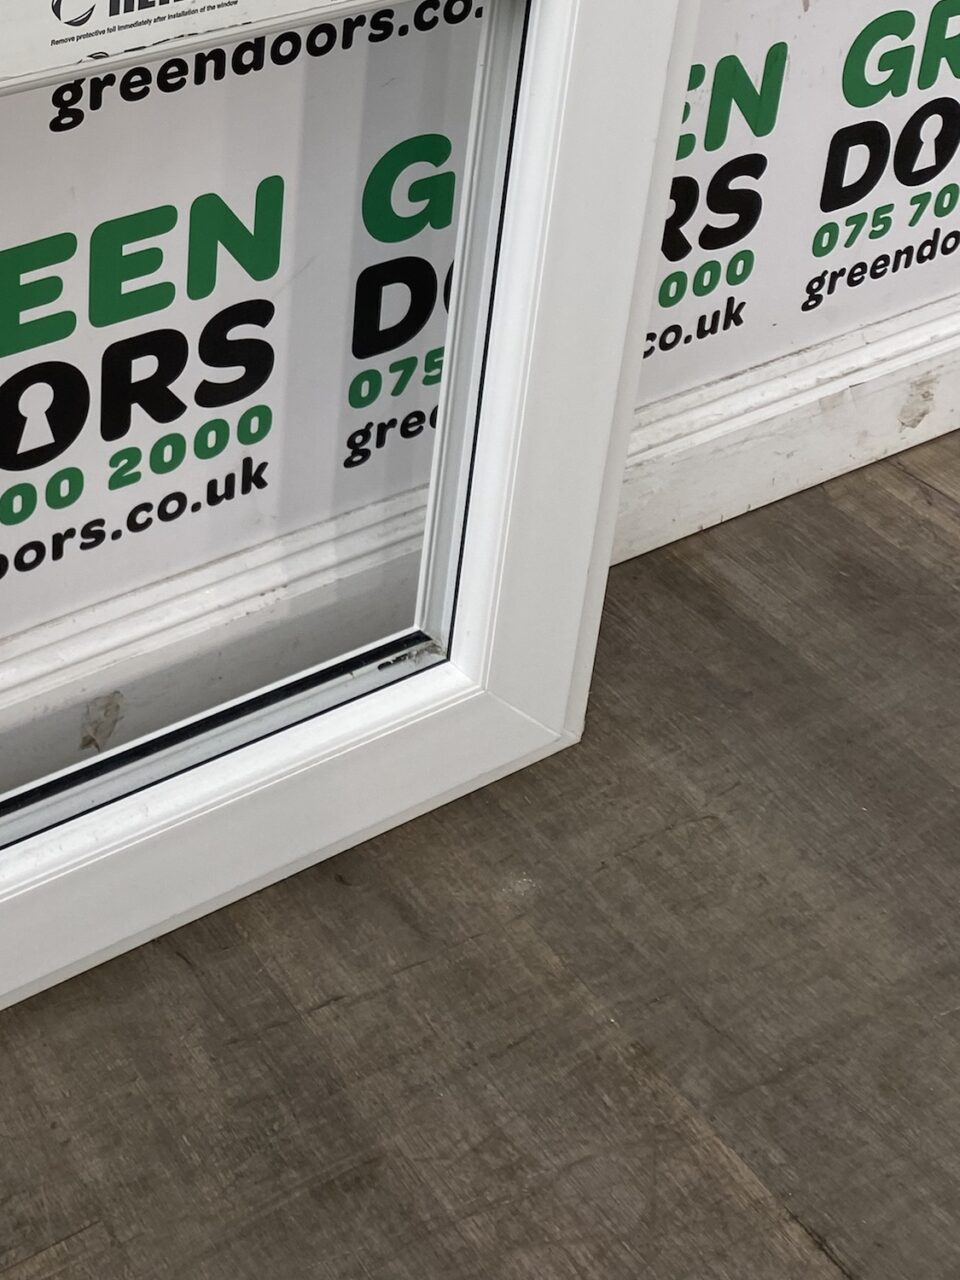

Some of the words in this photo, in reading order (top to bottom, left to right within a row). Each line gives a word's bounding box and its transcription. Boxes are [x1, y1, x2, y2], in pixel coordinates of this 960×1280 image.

[51, 36, 75, 46] Remove
[76, 30, 106, 43] protective
[117, 18, 152, 32] immediately
[153, 16, 166, 25] after
[167, 9, 199, 21] installation
[199, 7, 206, 15] of
[206, 5, 216, 13] the
[217, 0, 238, 10] window
[361, 132, 457, 244] G
[658, 249, 755, 308] 000
[812, 203, 895, 257] 075
[351, 255, 455, 360] D
[347, 345, 445, 409] 075
[108, 403, 273, 491] 2000
